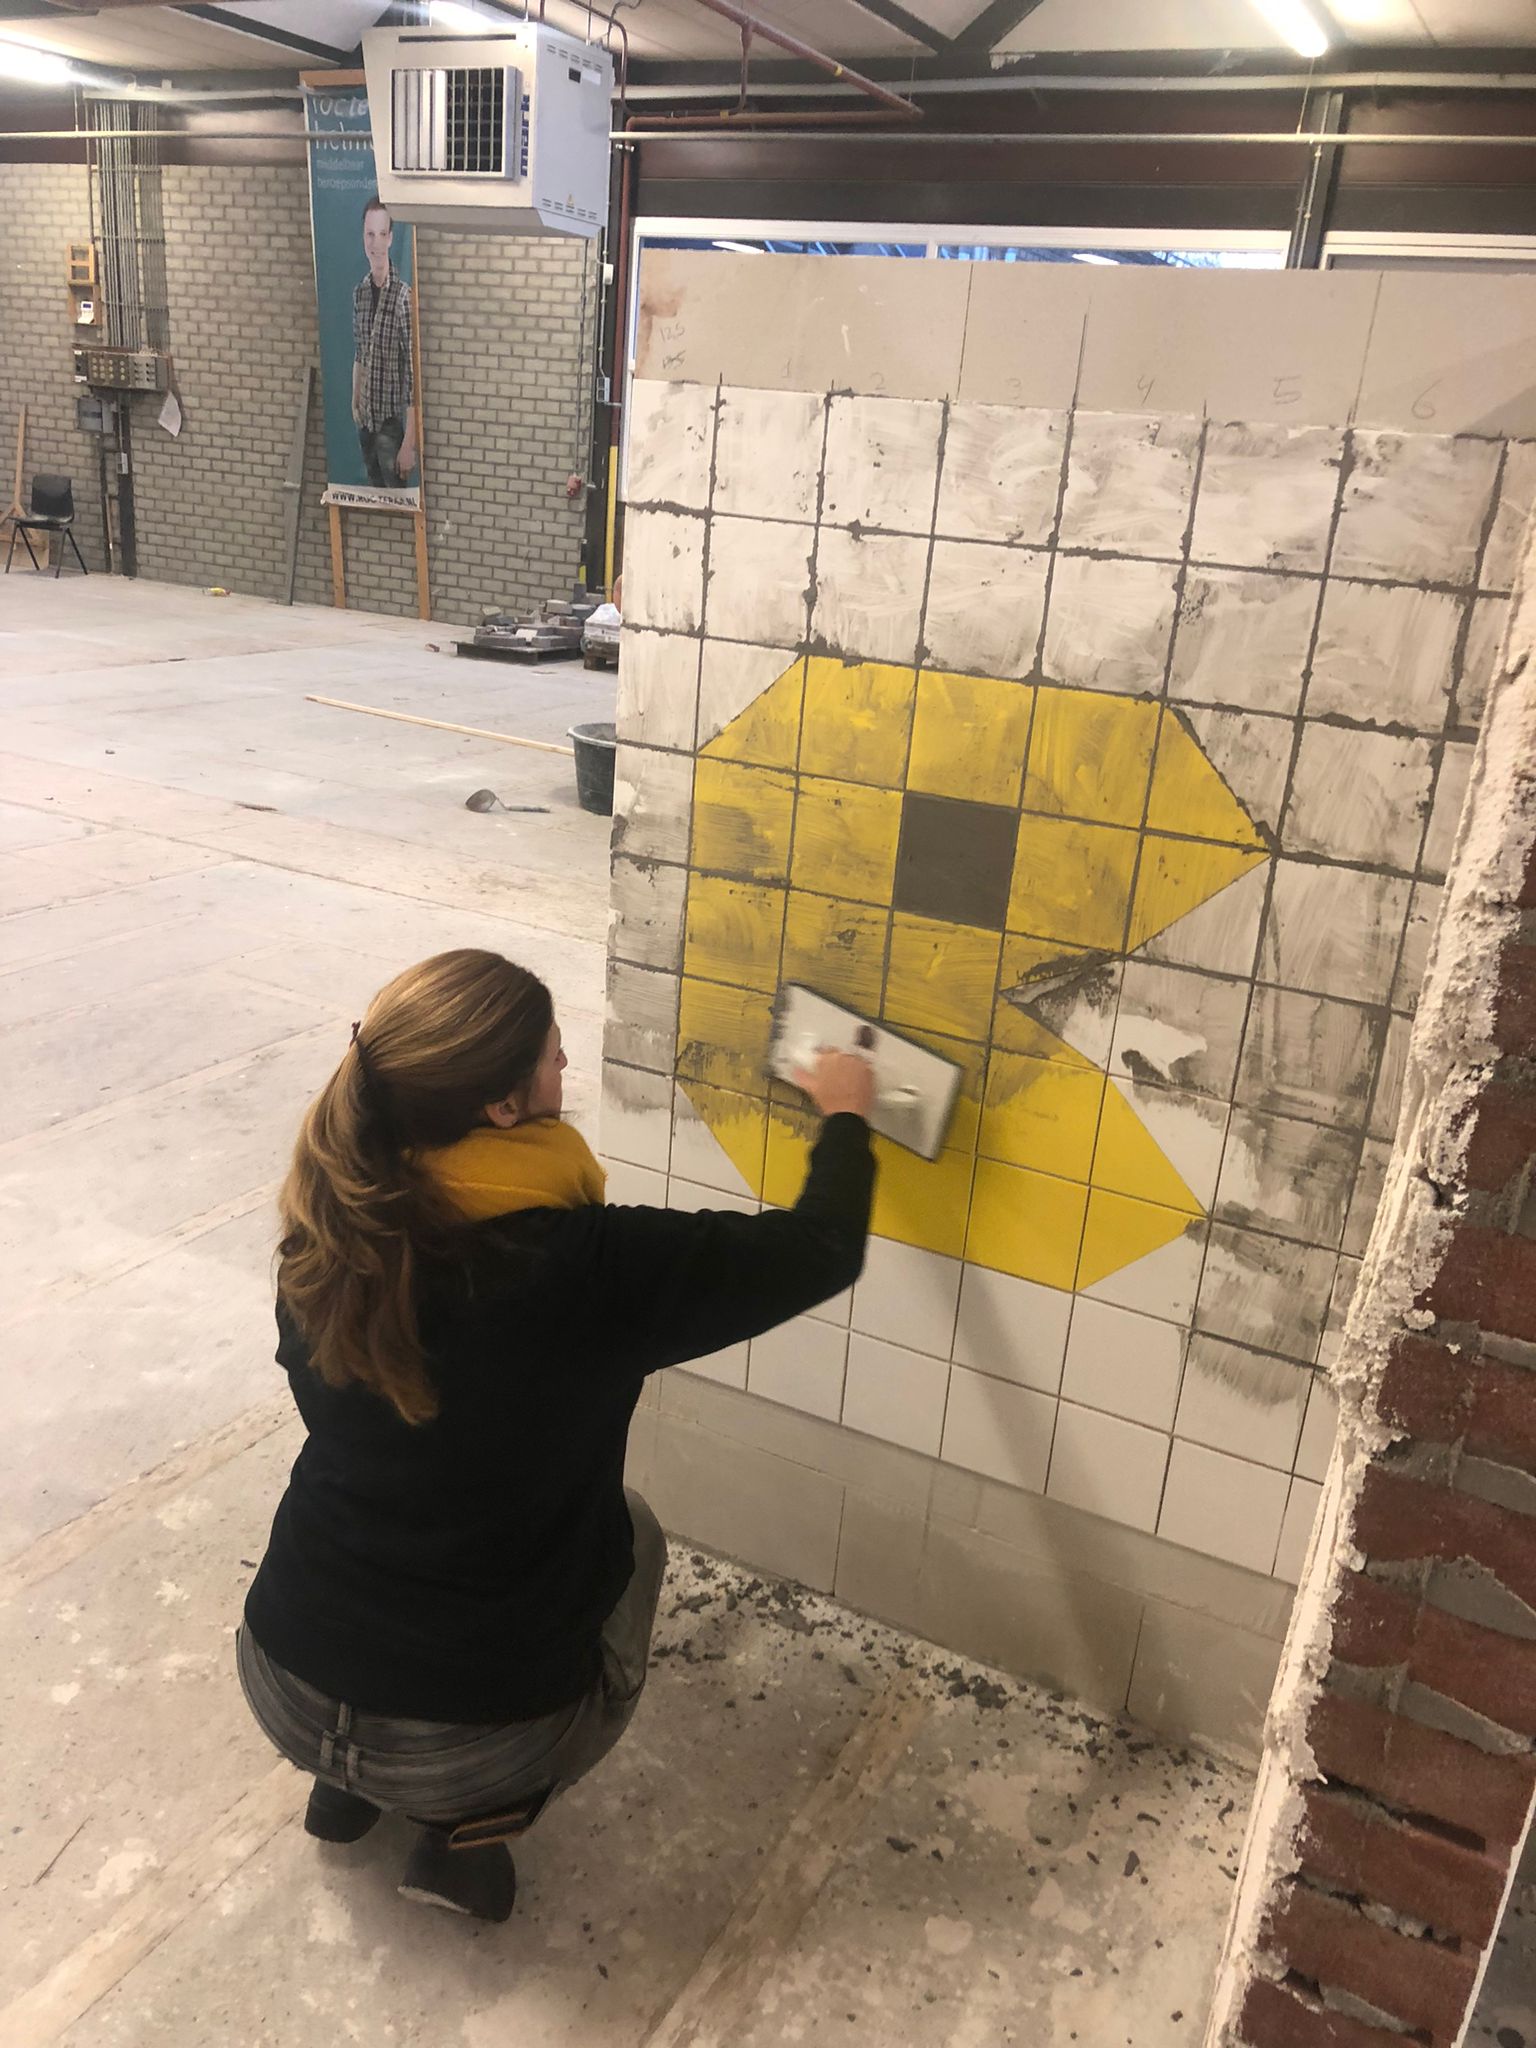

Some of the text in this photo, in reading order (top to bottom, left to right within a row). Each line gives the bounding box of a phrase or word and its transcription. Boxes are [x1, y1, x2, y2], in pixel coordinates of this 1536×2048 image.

[868, 371, 887, 391] 2
[1004, 377, 1023, 400] 3
[1136, 373, 1156, 407] 4
[1271, 373, 1303, 406] 5
[1411, 376, 1446, 420] 6
